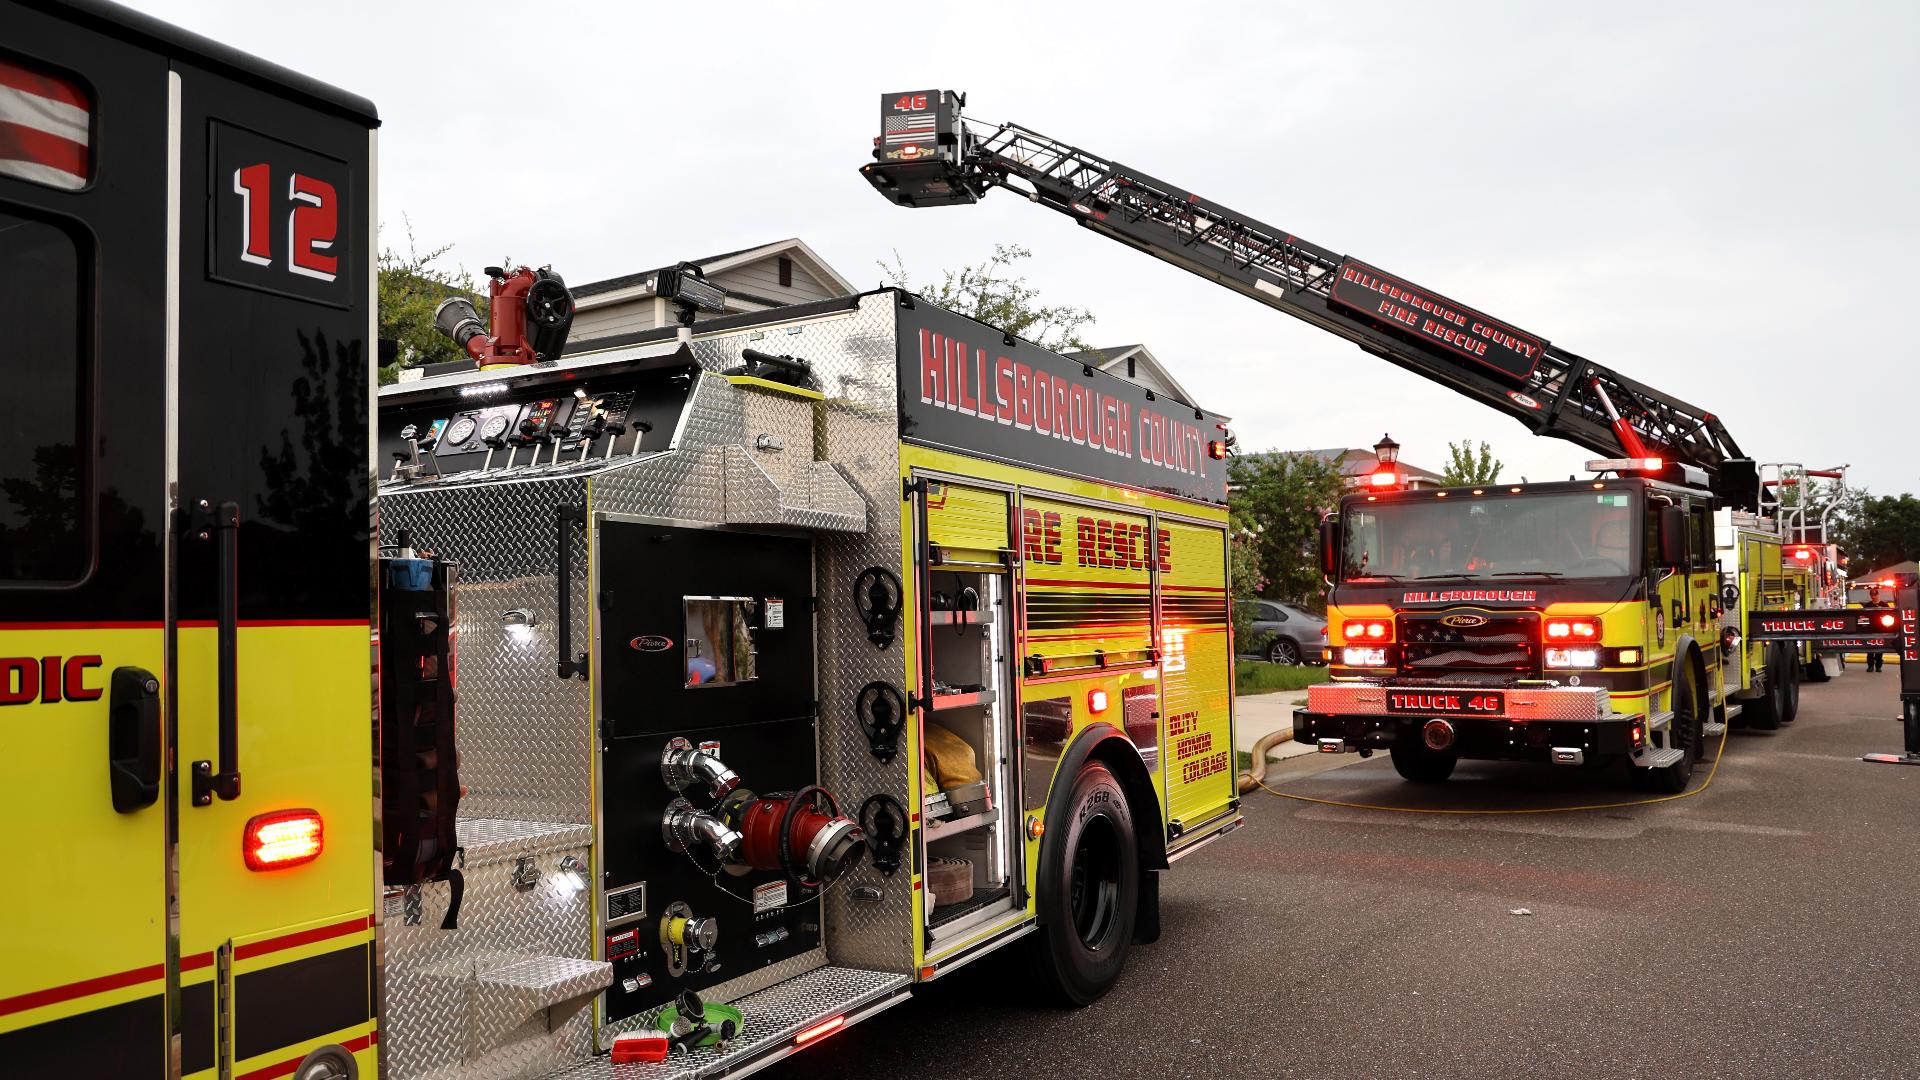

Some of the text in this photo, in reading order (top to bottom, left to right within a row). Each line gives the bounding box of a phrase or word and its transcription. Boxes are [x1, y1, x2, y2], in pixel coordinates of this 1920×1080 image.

[894, 95, 928, 112] 46
[233, 163, 338, 282] 12
[1342, 267, 1537, 358] HILLSBOROUGH COUNTY
[1377, 300, 1489, 356] FIRE RESCUE
[919, 328, 1209, 479] HILLSBOROUGH COUNTY
[1403, 590, 1537, 603] HILLSBOROUGH
[1762, 620, 1845, 632] TRUCK 46
[1902, 609, 1918, 661] HCFR
[1391, 694, 1498, 710] TRUCK 46
[1169, 711, 1199, 736] DUTY
[1177, 732, 1212, 760] HONOR
[1183, 751, 1227, 784] COURAGE
